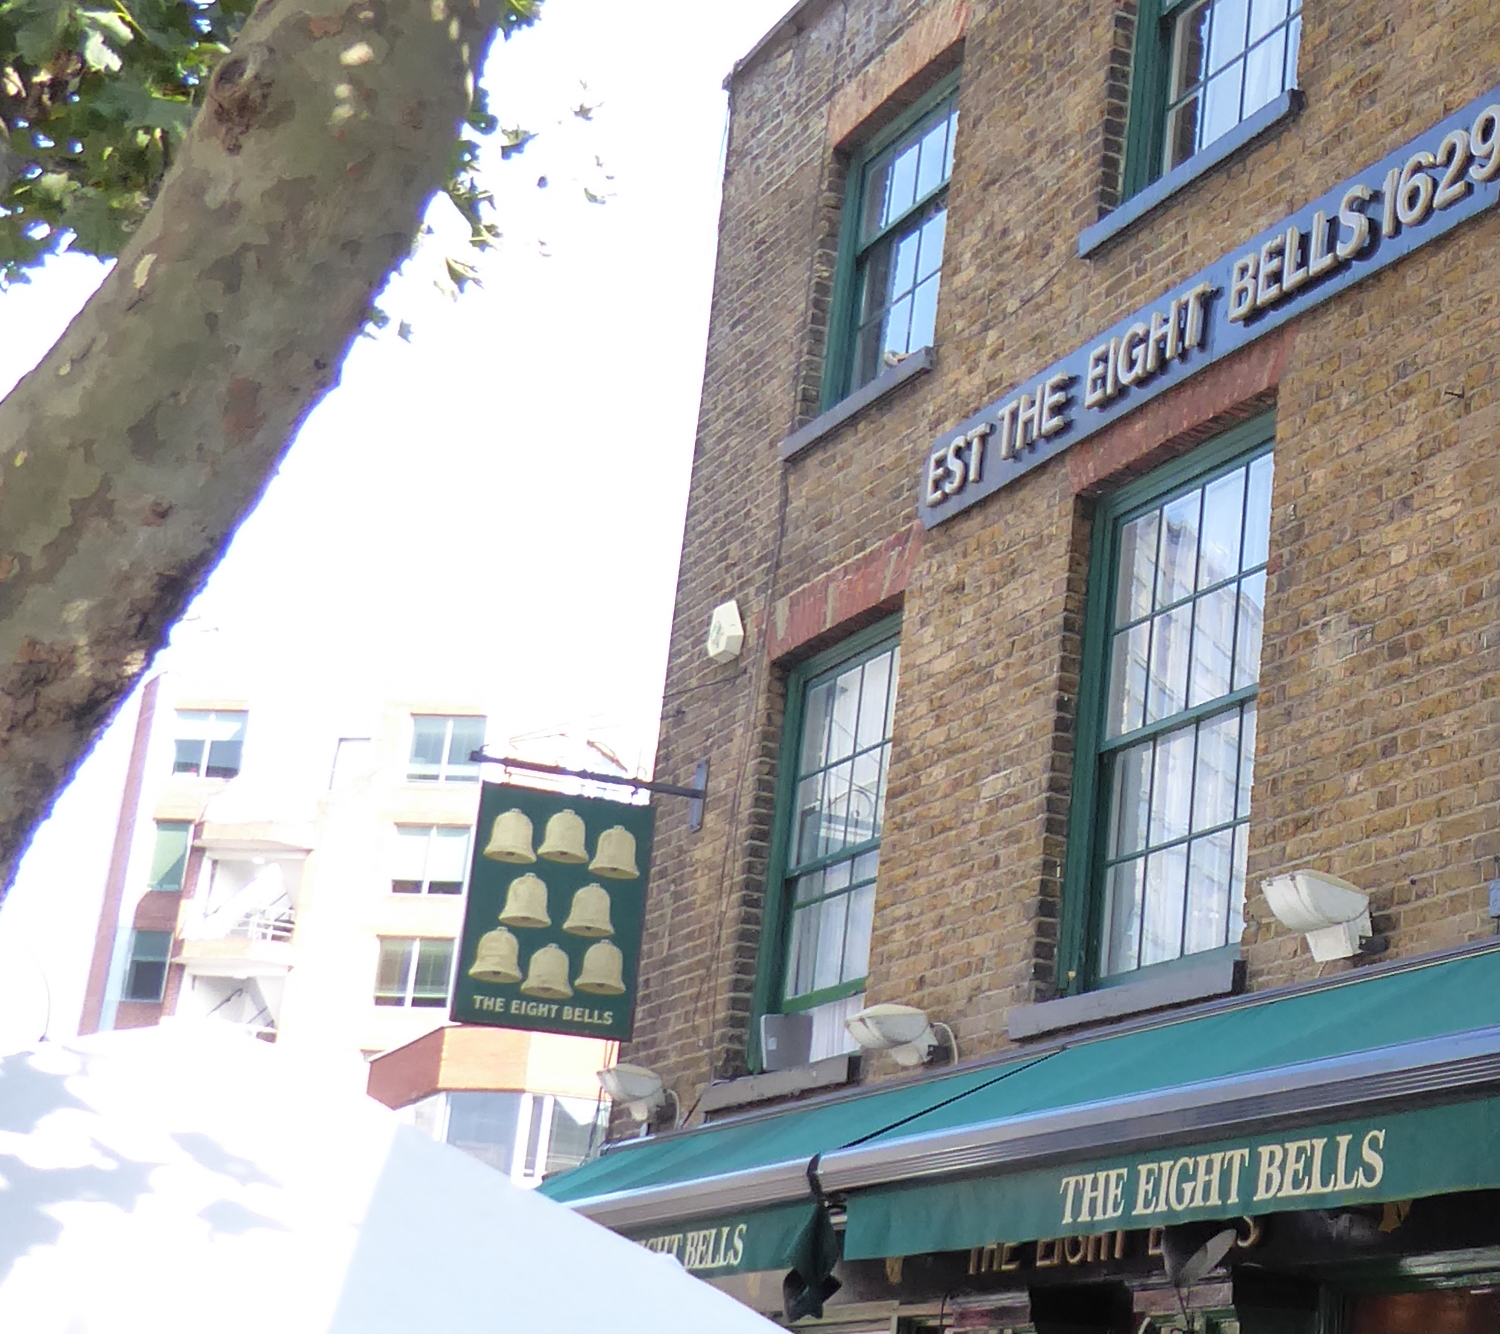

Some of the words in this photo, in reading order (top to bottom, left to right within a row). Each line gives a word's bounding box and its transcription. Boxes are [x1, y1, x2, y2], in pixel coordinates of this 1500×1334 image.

[926, 422, 992, 507] EST
[998, 371, 1069, 460] THE
[1084, 281, 1213, 409] EIGHT
[1227, 184, 1372, 324] BELLS
[473, 995, 506, 1012] THE
[510, 999, 560, 1018] EIGHT
[562, 1006, 614, 1025] BELLS
[1059, 1168, 1128, 1225] THE
[1132, 1148, 1250, 1216] EIGHT
[1253, 1129, 1386, 1201] BELLS
[683, 1223, 748, 1269] BELLS
